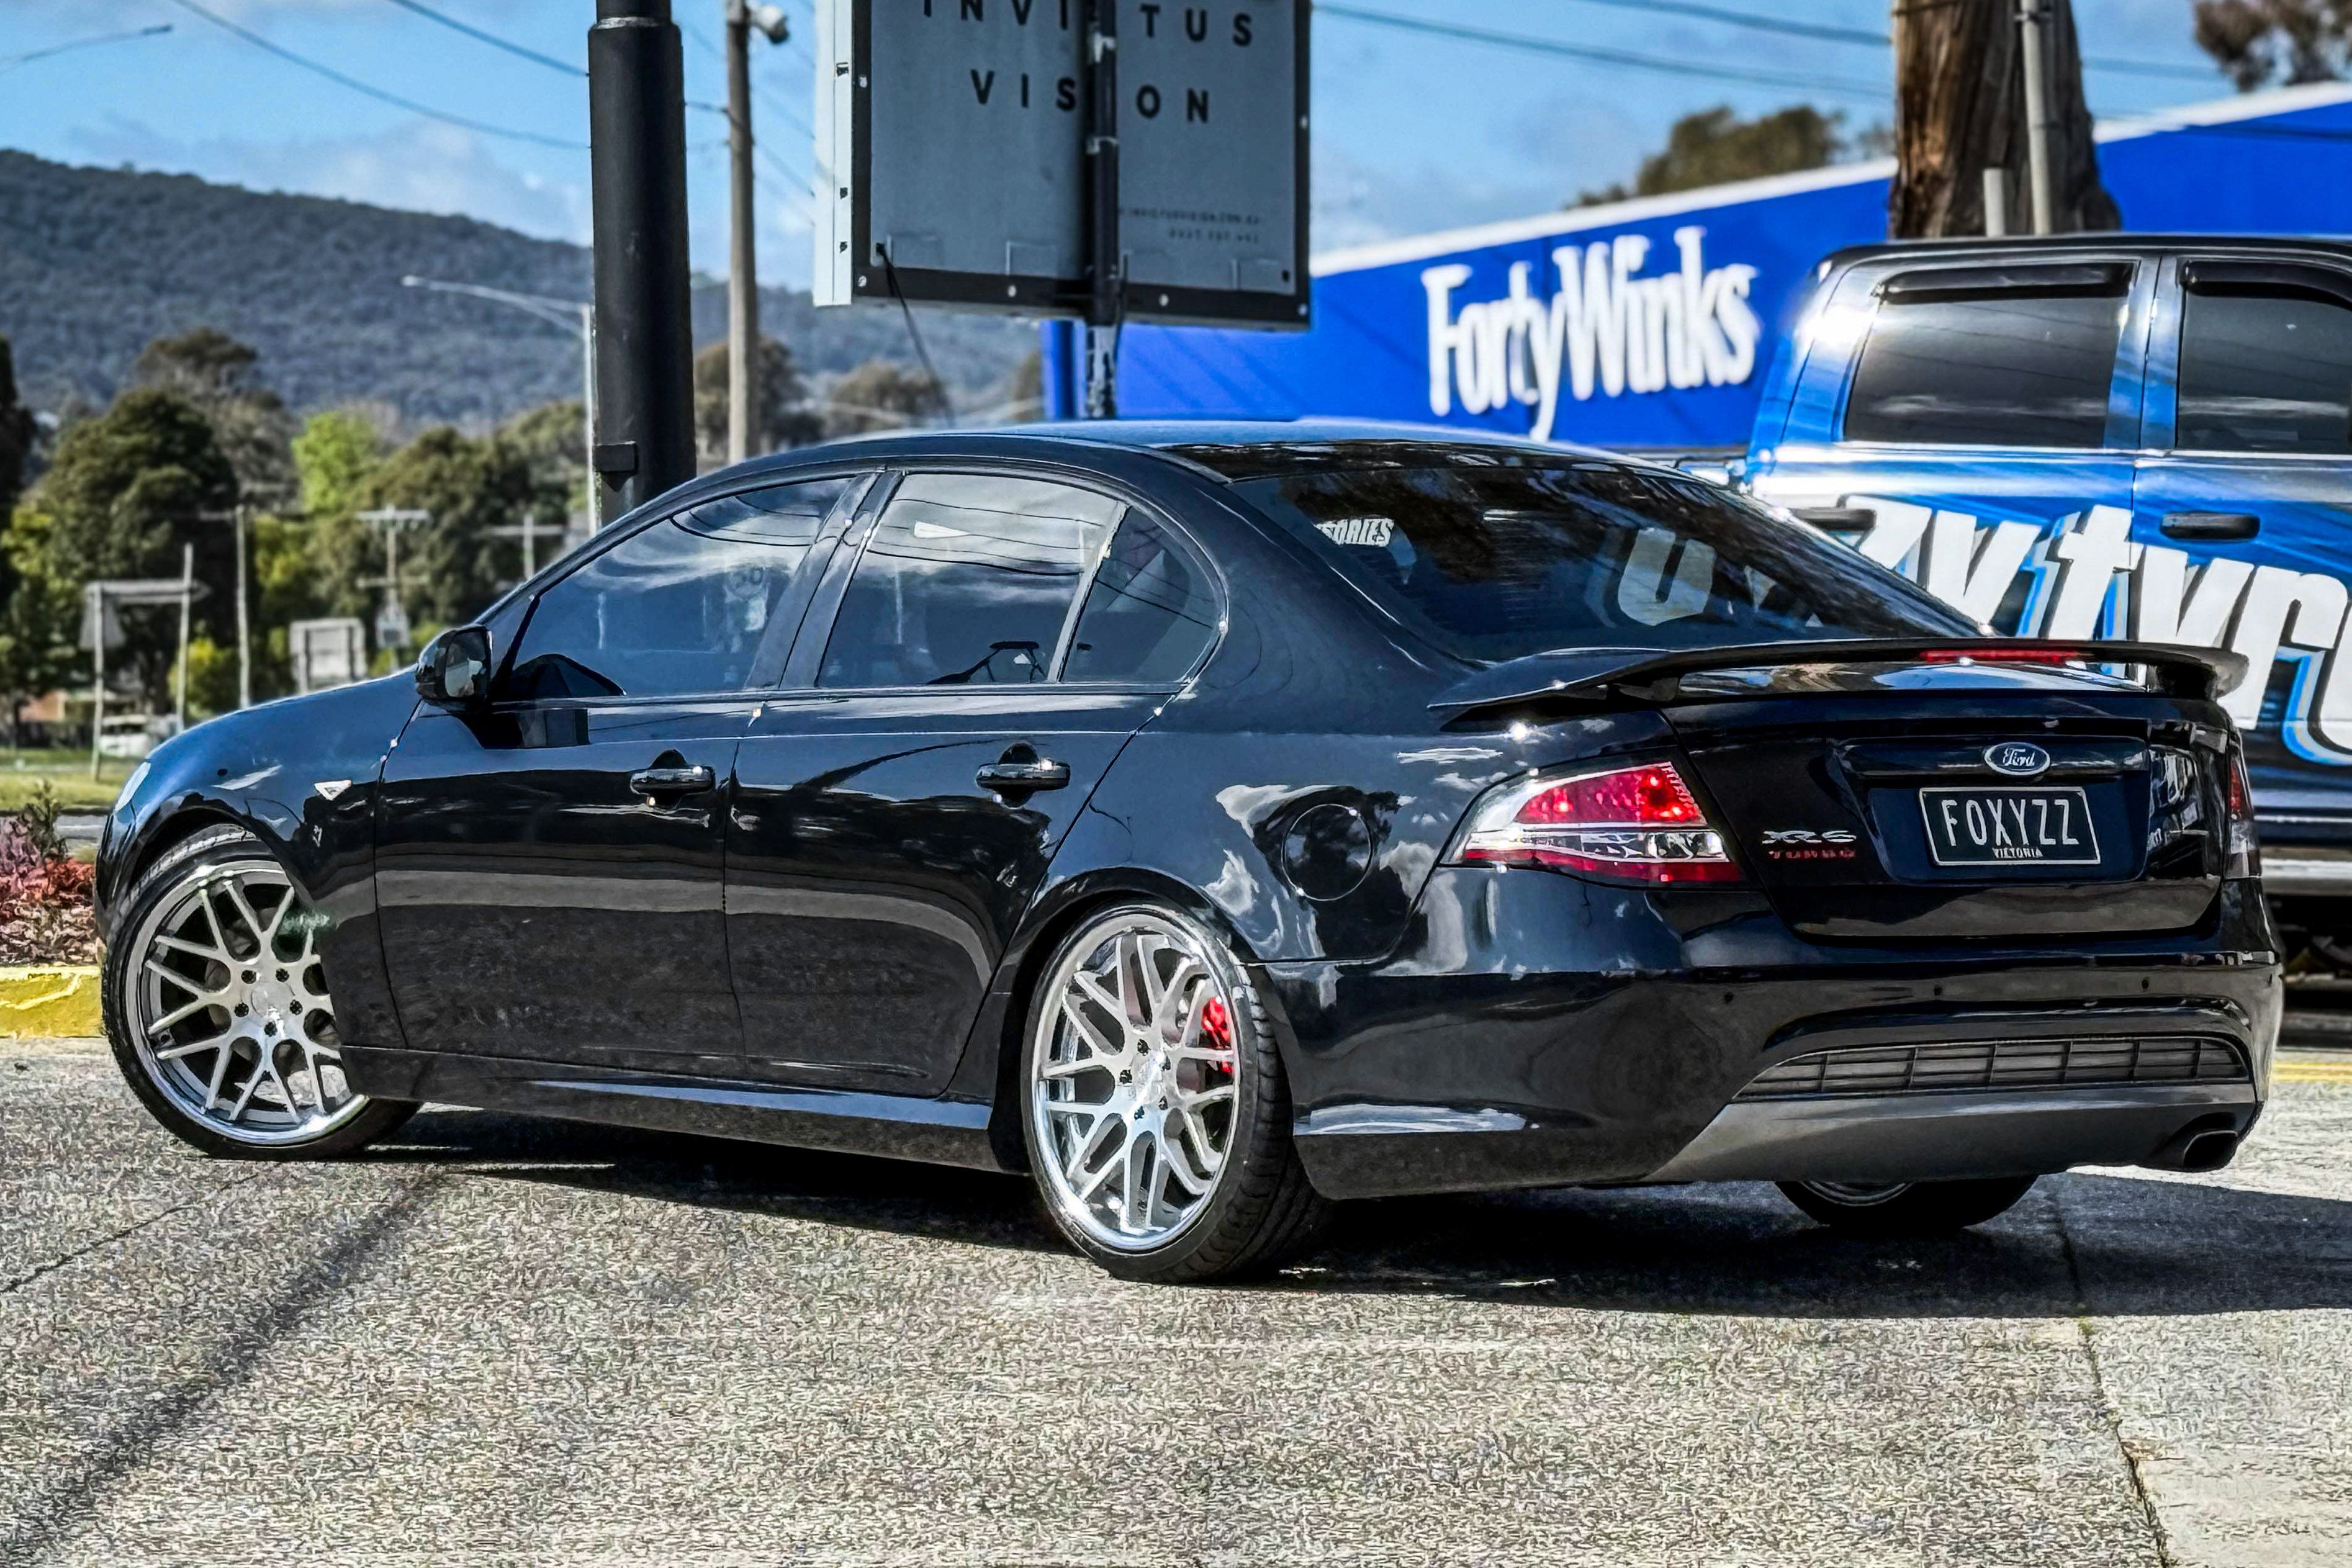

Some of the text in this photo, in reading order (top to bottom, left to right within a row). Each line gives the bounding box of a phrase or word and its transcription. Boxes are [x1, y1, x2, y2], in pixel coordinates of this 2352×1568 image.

[922, 0, 1253, 47] INVITUS
[970, 70, 1209, 124] VISON
[2002, 747, 2035, 767] Ford
[1941, 798, 2079, 847] FOXYZZ
[1991, 847, 2044, 858] VICTORIA
